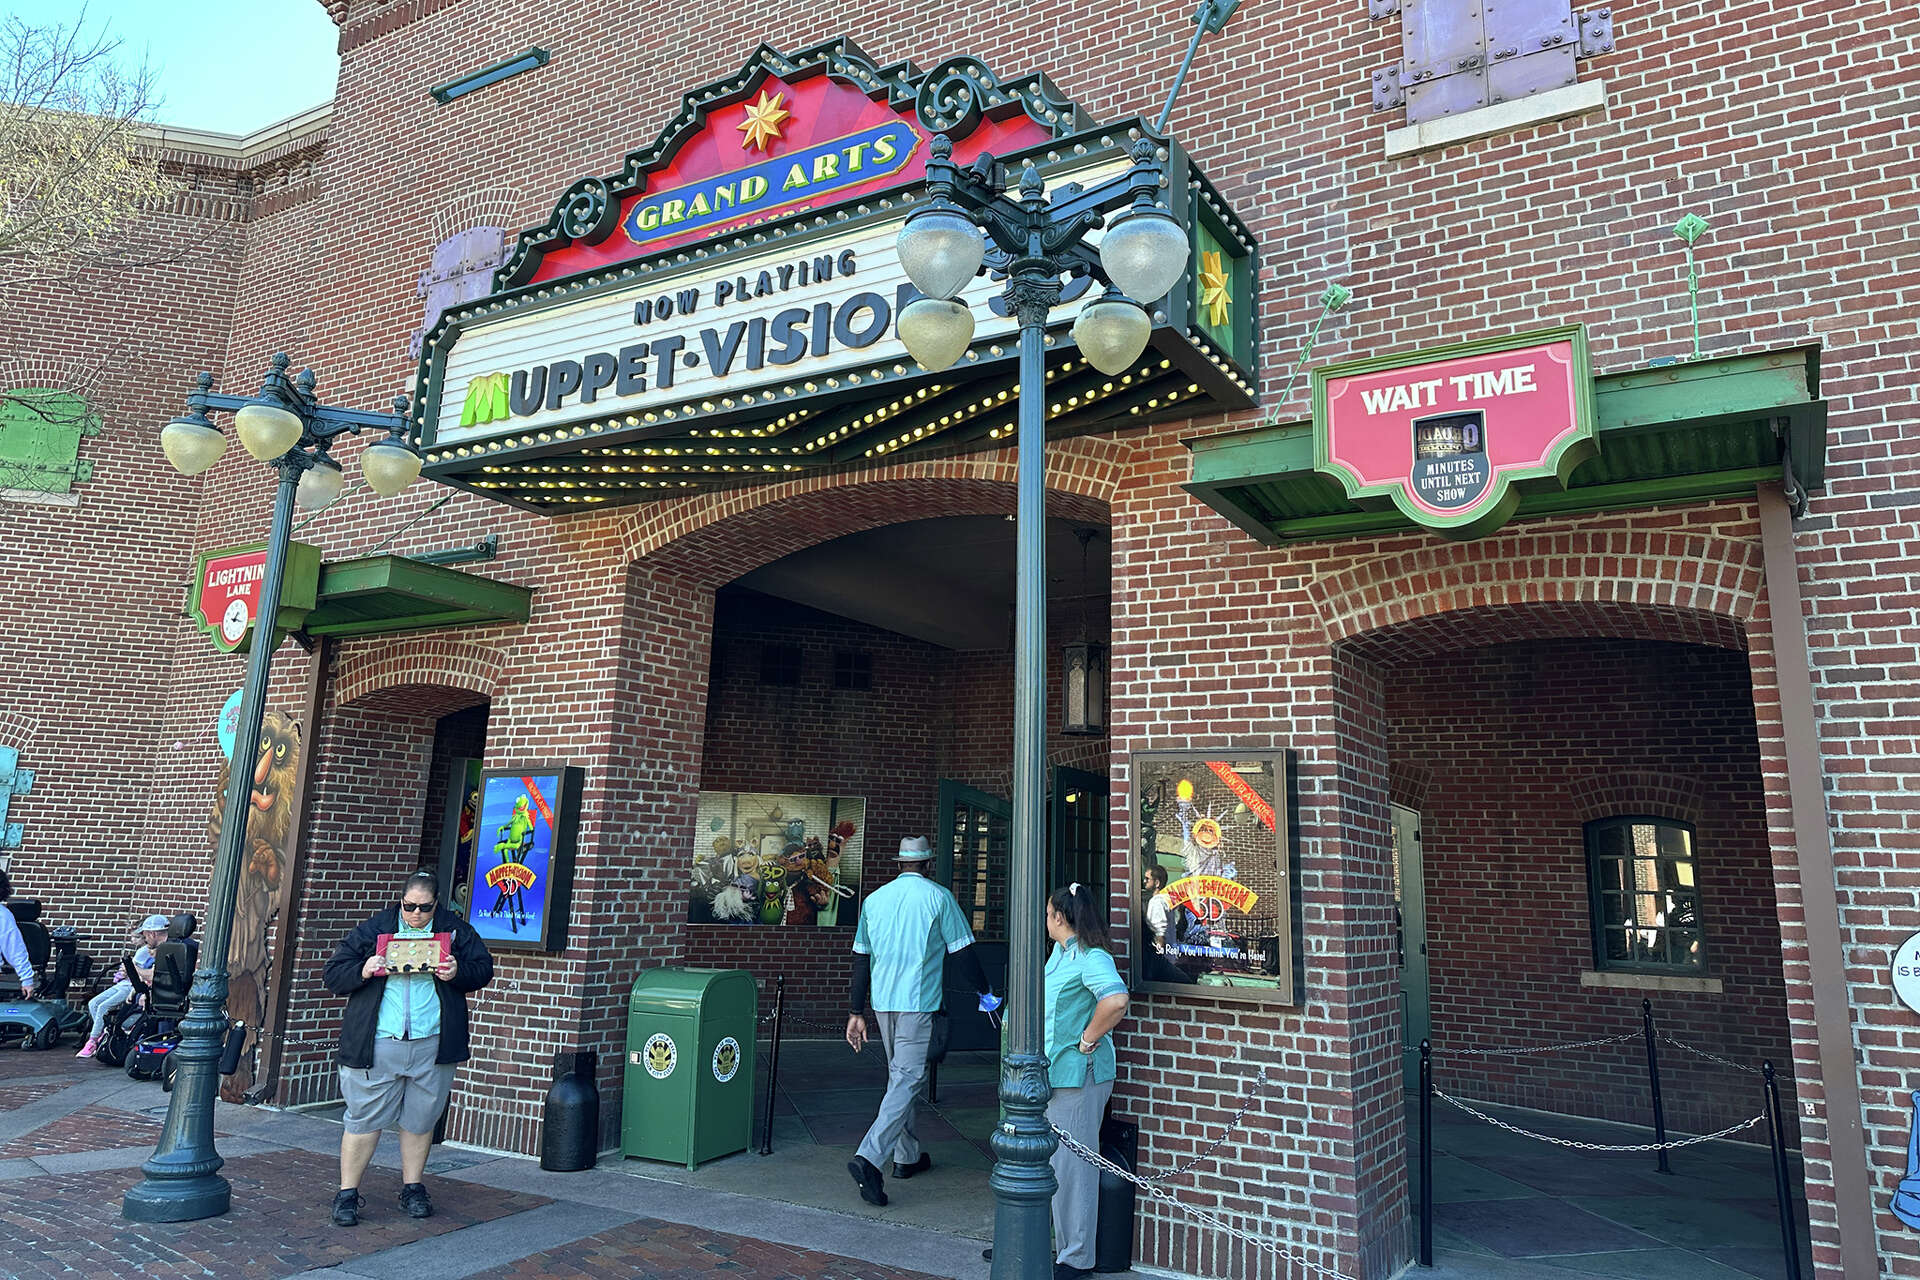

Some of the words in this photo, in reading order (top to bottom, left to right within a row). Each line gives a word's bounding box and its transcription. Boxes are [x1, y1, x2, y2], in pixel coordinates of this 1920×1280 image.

[636, 175, 769, 231] GRAND
[782, 134, 897, 192] ARTS
[634, 288, 699, 325] NOW
[715, 249, 856, 306] PLAYING
[1360, 378, 1443, 415] WAIT
[1450, 364, 1537, 402] TIME
[1427, 459, 1474, 475] MINUTES
[1421, 476, 1451, 489] UNTIL
[1454, 472, 1481, 485] NEXT
[1437, 488, 1466, 501] SHOW
[208, 564, 265, 587] LIGHTNIN
[226, 583, 251, 598] LANE
[1218, 765, 1238, 785] NOW
[762, 866, 785, 880] 3D
[1197, 897, 1224, 921] 3D
[1204, 946, 1223, 958] Think
[1897, 965, 1910, 977] IS
